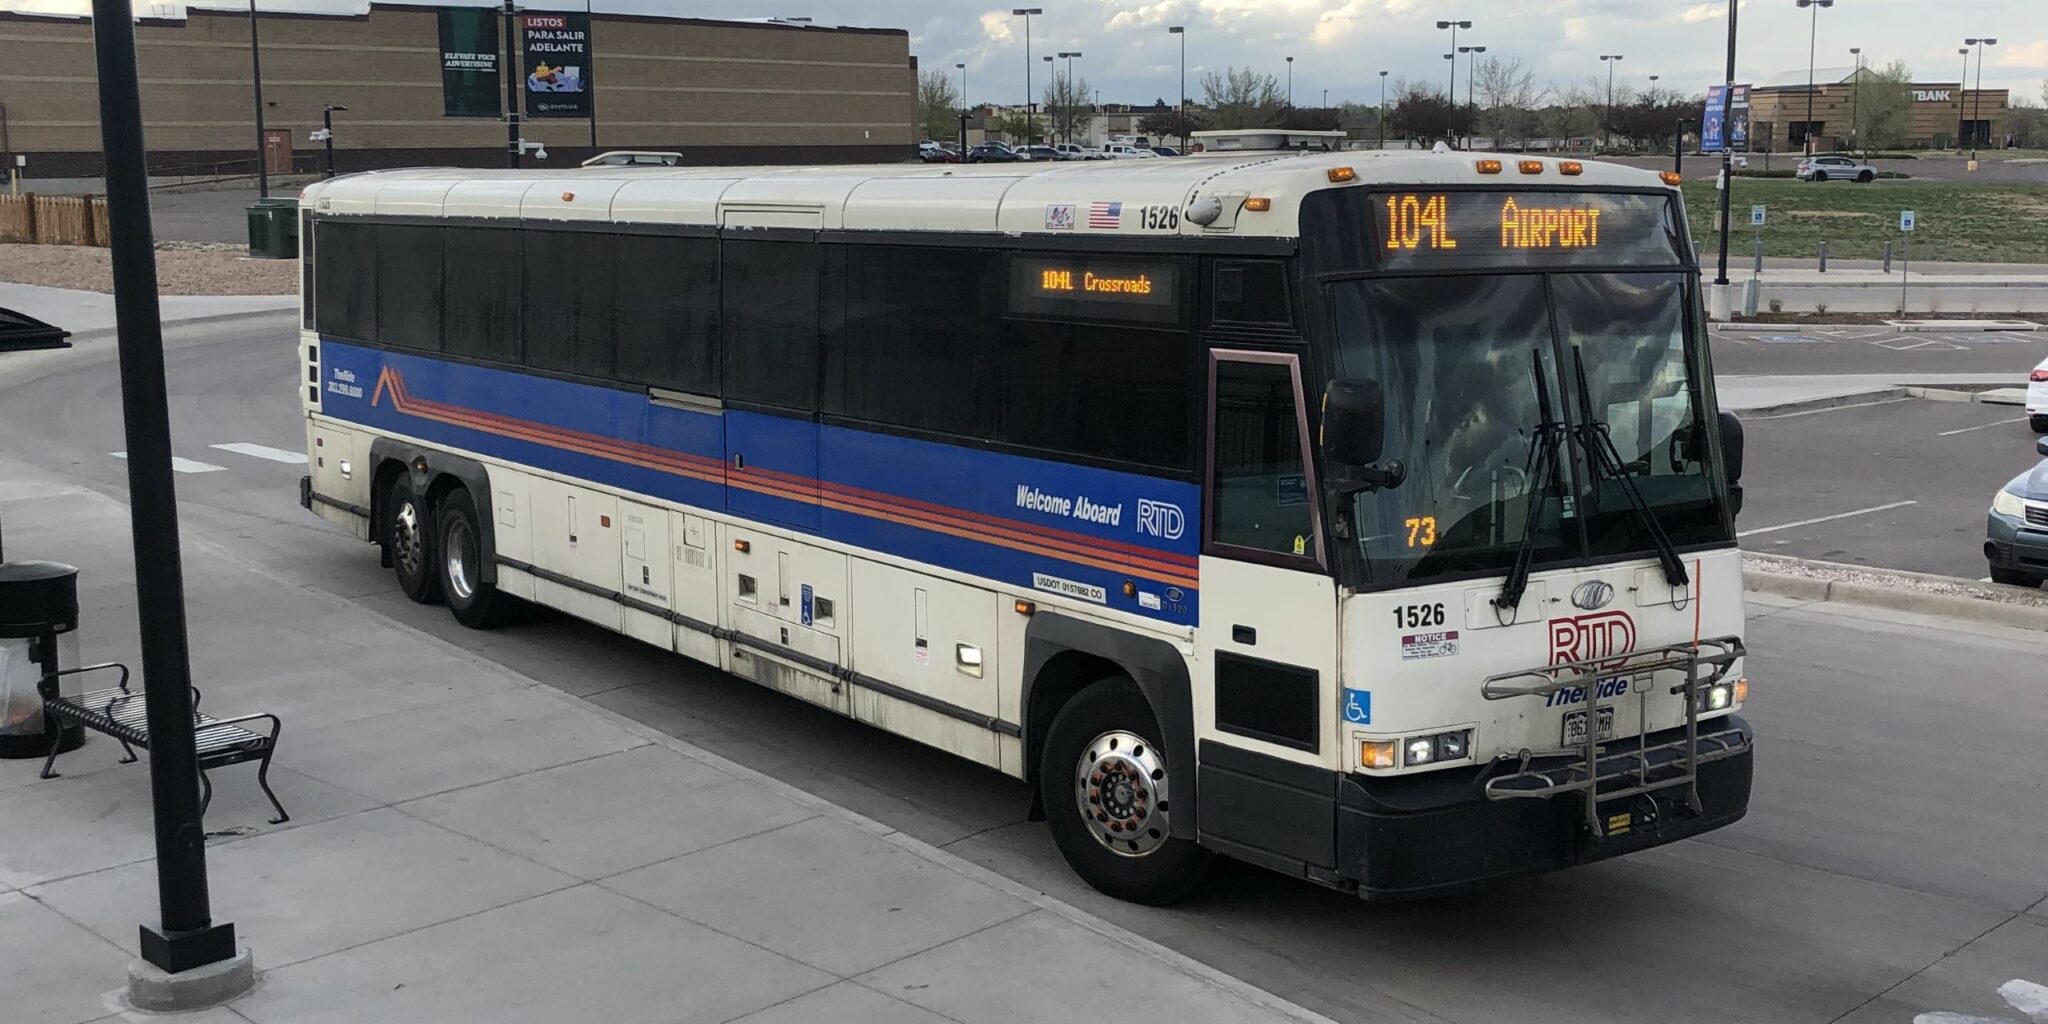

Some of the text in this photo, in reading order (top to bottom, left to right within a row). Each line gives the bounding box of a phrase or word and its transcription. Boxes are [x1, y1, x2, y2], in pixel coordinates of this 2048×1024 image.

[528, 17, 563, 27] LISTOS
[528, 30, 585, 40] PARA SALIR
[445, 52, 496, 61] ELEVATE YOUR
[529, 43, 584, 53] ADELANTE
[445, 60, 493, 68] ADVERTISING
[1140, 205, 1178, 230] 1526
[1386, 194, 1457, 250] 104L
[1041, 270, 1151, 294] 104L Crossroads
[1016, 484, 1122, 527] Welcome Aboard
[1136, 498, 1185, 540] RTD
[1405, 516, 1436, 548] 73
[1037, 576, 1061, 590] USDOT
[1090, 588, 1103, 600] CO
[1392, 602, 1446, 629] 1526
[1415, 633, 1448, 643] NOTICE
[1549, 610, 1637, 679] RTD
